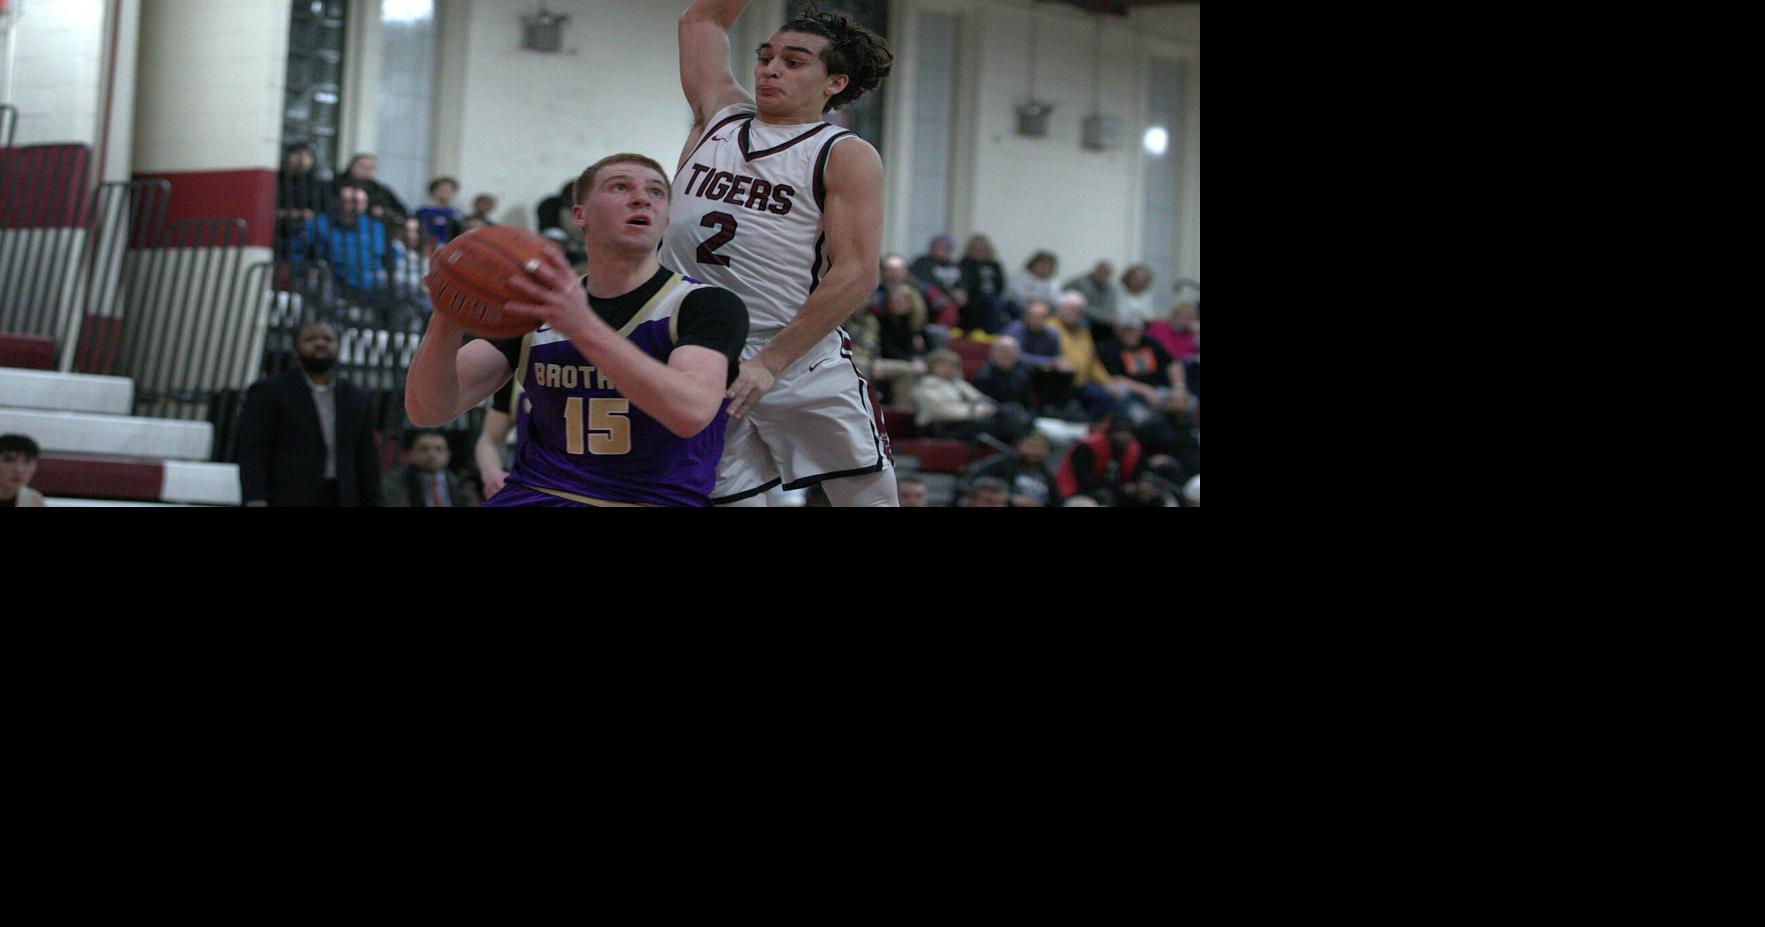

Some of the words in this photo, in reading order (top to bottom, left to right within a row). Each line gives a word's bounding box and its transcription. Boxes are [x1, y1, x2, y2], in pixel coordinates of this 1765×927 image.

[684, 162, 796, 216] TIGERS
[696, 210, 738, 268] 2
[563, 396, 631, 455] 15
